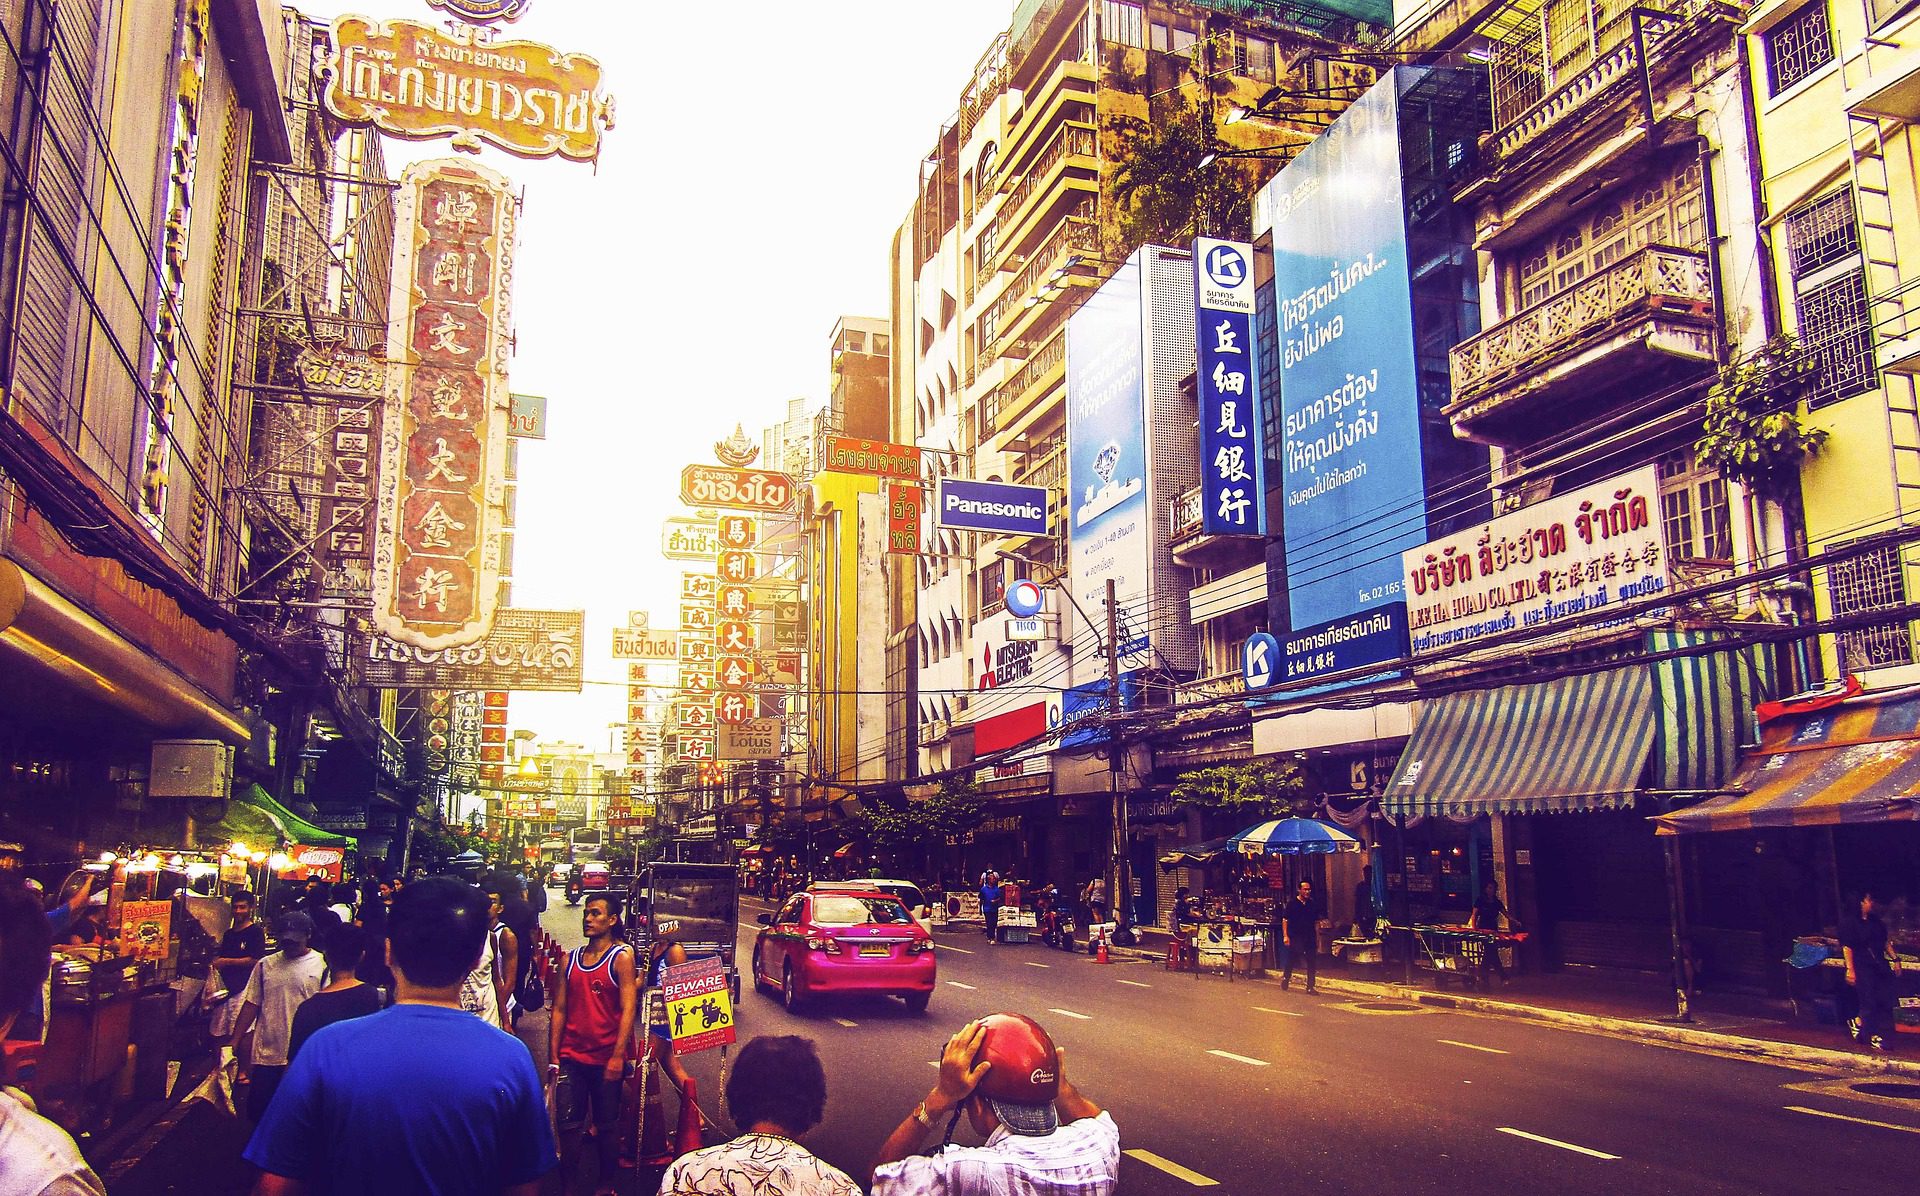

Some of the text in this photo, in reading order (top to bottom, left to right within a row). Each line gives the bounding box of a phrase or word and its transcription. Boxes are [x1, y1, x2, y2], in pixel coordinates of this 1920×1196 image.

[1206, 289, 1235, 300] ธนาคาร
[1284, 312, 1345, 369] ยังไม่พอ
[1286, 368, 1378, 438] ธนาคารต้อง
[1212, 319, 1253, 526] 丘細見銀行
[1286, 402, 1379, 478] ให้คุณมั่งคั่ง
[827, 440, 919, 475] โรงรับจำนำ
[691, 474, 786, 506] ทองใบ
[945, 494, 1043, 520] Panasonic
[1411, 545, 1472, 596] บริษัท
[1574, 486, 1649, 544] จำกัด
[1371, 586, 1382, 598] 02
[1384, 581, 1399, 596] 165
[1016, 621, 1037, 632] TISCO
[1410, 604, 1432, 630] LEE
[1433, 602, 1450, 626] HA
[1452, 594, 1486, 621] HUAD
[1286, 613, 1392, 656] ธนาคารเกียรตินาคิน
[687, 578, 709, 758] 和成興大金行
[996, 639, 1039, 668] MITSUBISHI
[996, 655, 1033, 685] ELECTRIC
[730, 736, 772, 748] Lotus
[608, 809, 620, 819] 24
[665, 975, 723, 996] BEWARE
[666, 994, 676, 1002] OF
